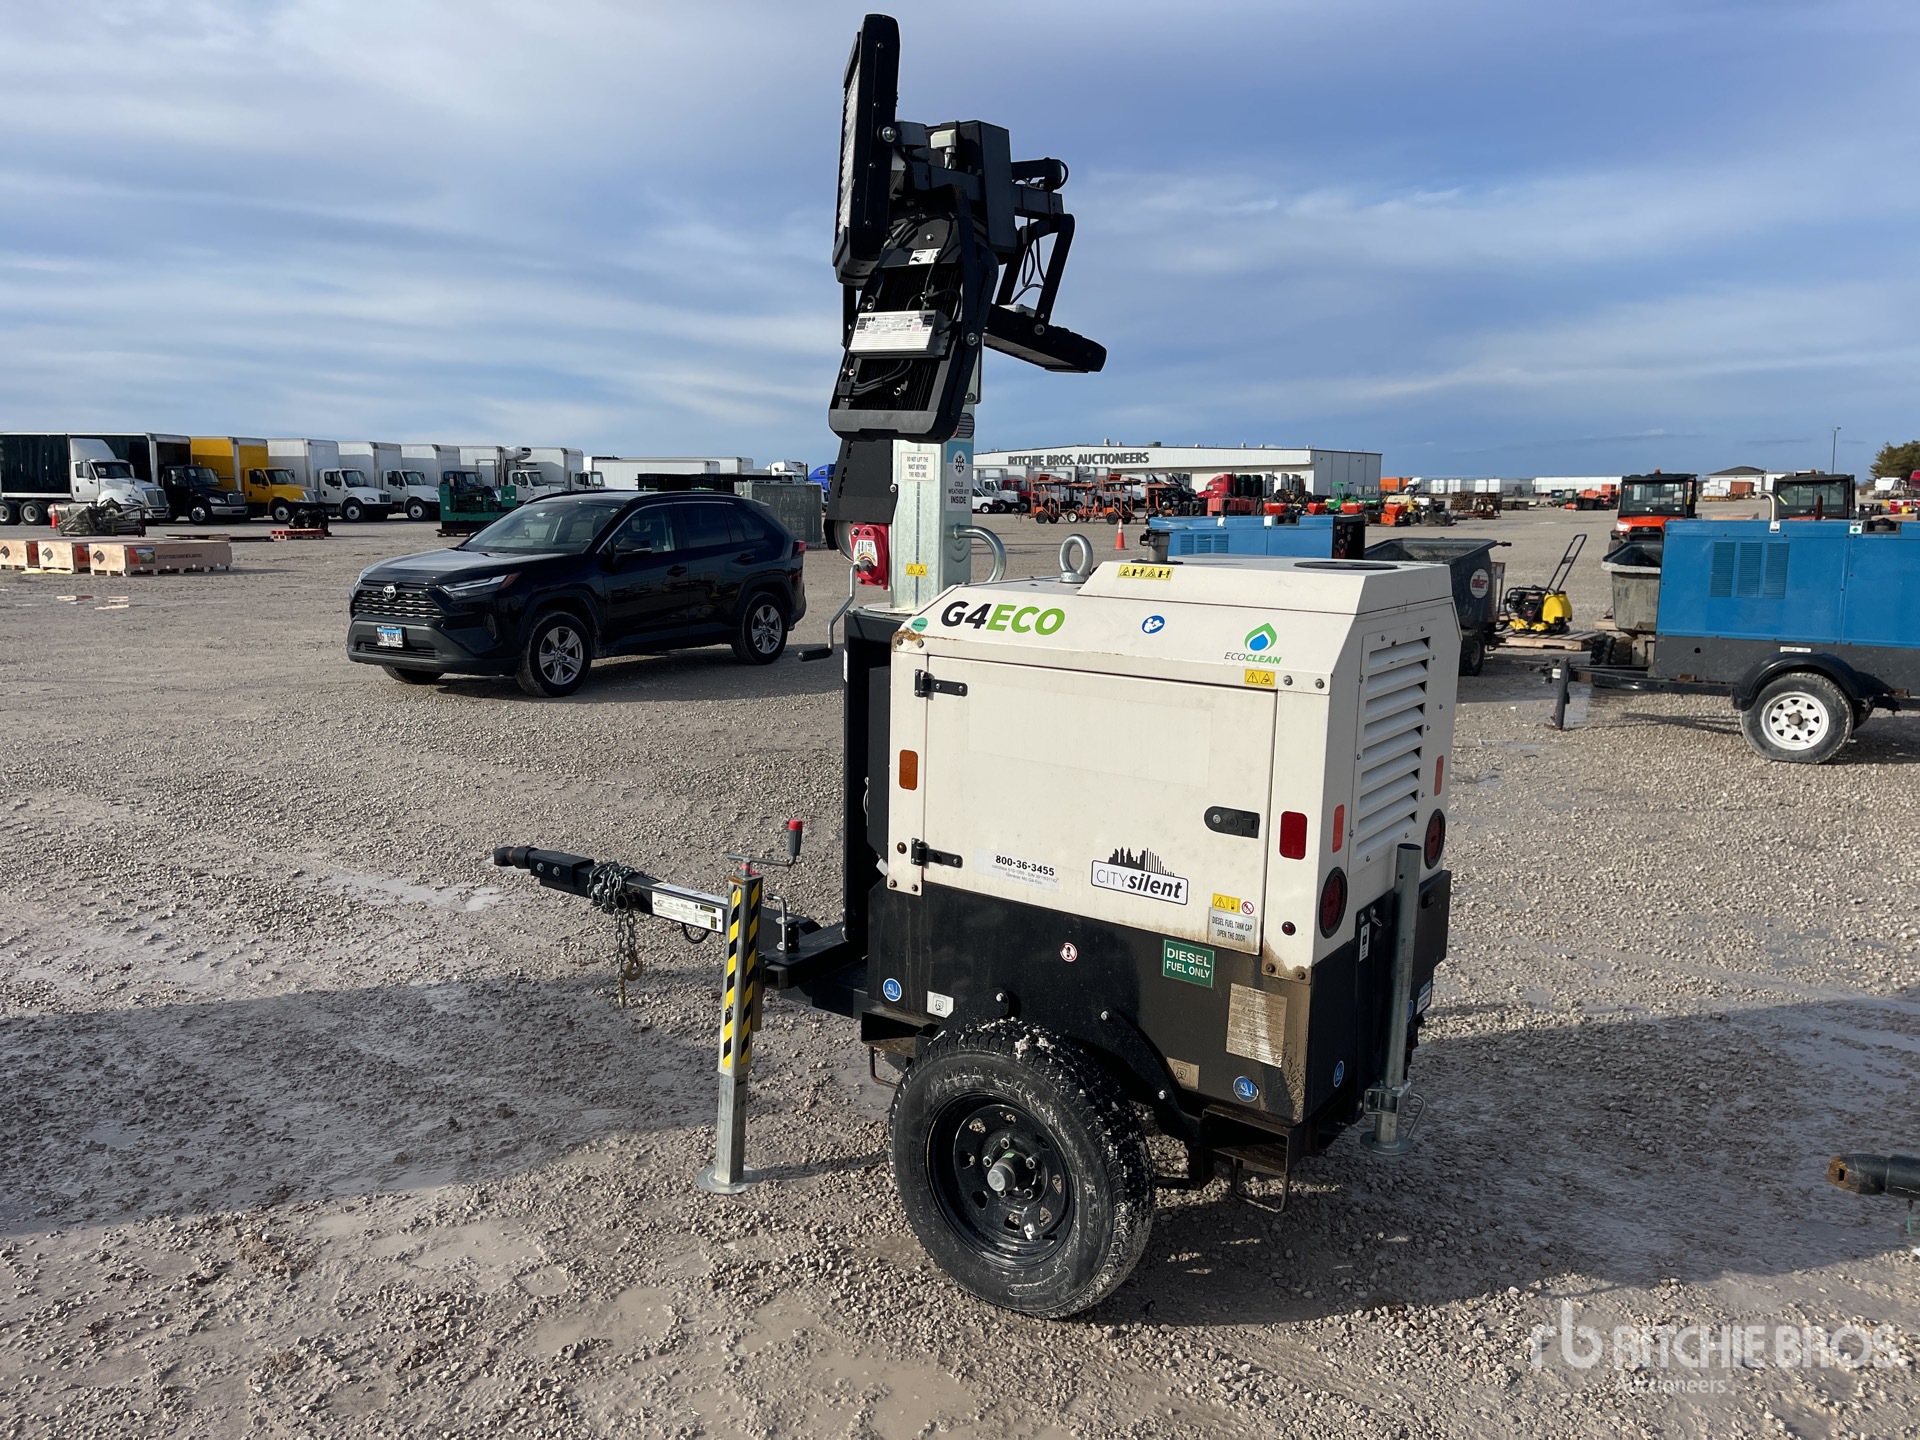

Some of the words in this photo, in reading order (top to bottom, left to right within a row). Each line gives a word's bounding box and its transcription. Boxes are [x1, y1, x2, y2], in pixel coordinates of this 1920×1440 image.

[1008, 455, 1044, 466] RITCHIE
[1047, 454, 1075, 466] BROS.
[1077, 452, 1150, 464] AUCTIONEERS
[941, 600, 1065, 636] G4ECO
[1224, 652, 1282, 664] ECOCLEAN
[996, 855, 1054, 876] 800-36-3455
[1097, 869, 1182, 898] CITYsilent
[1212, 916, 1224, 927] DIESEL
[1224, 919, 1234, 928] FUEL
[1235, 921, 1244, 930] TANK
[1217, 929, 1227, 938] OPEN
[1235, 933, 1246, 942] DOOR
[1167, 947, 1211, 968] DIESEL
[1166, 960, 1186, 974] FUEL
[1188, 966, 1210, 979] ONLY
